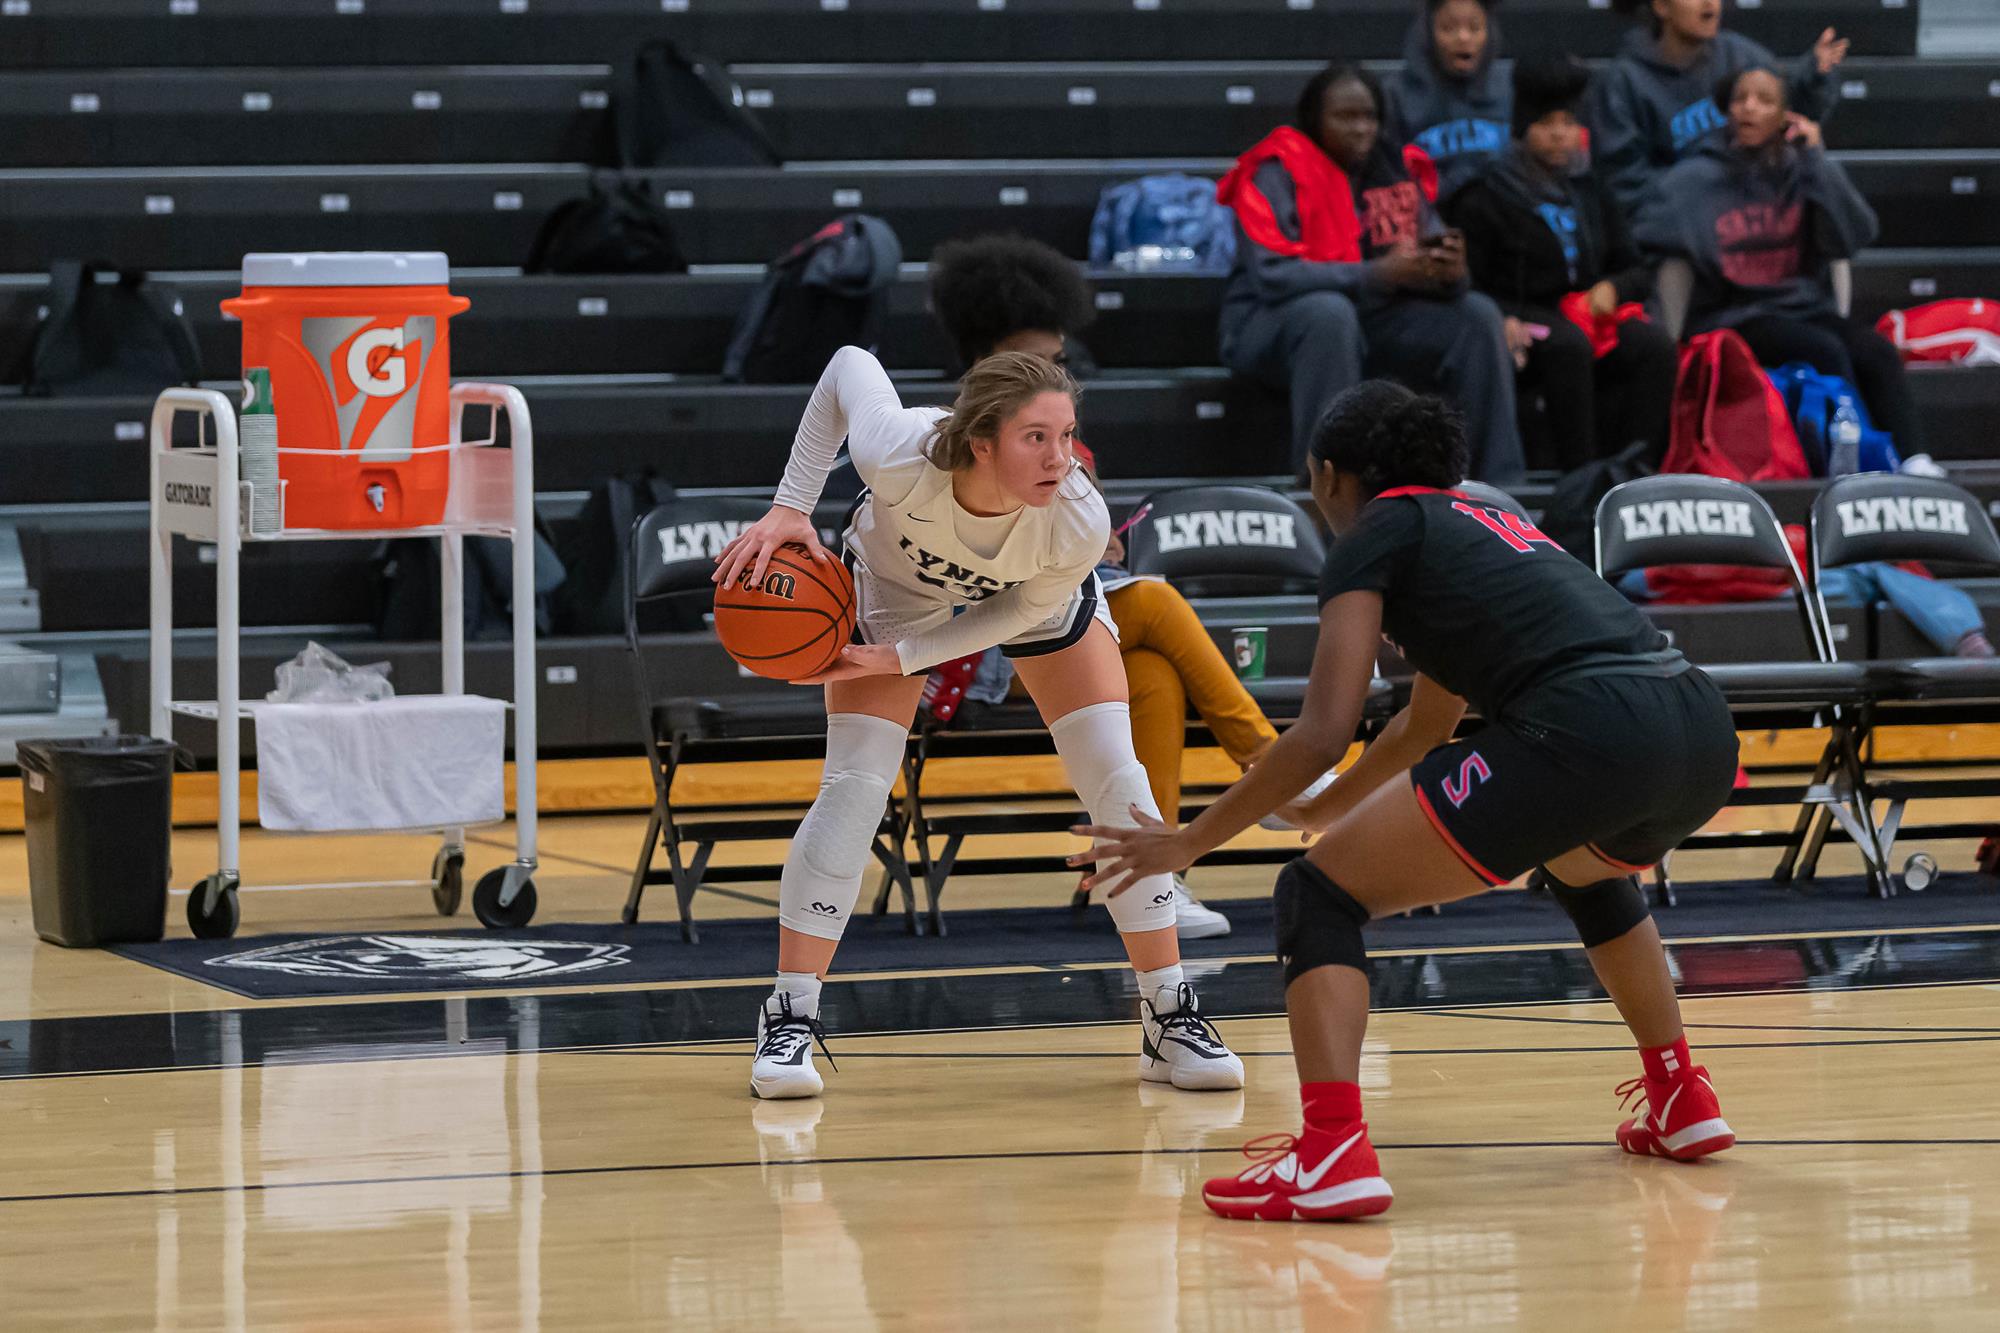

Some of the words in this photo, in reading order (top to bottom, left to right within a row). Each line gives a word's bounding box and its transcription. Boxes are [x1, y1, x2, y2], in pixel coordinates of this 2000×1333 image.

[346, 326, 407, 398] G
[164, 481, 212, 507] GATORADE
[1153, 510, 1297, 553] LYNCH
[1451, 501, 1567, 553] 14
[1618, 498, 1755, 542] LYNCH
[1835, 496, 1970, 538] LYNCH
[1441, 750, 1492, 809] S
